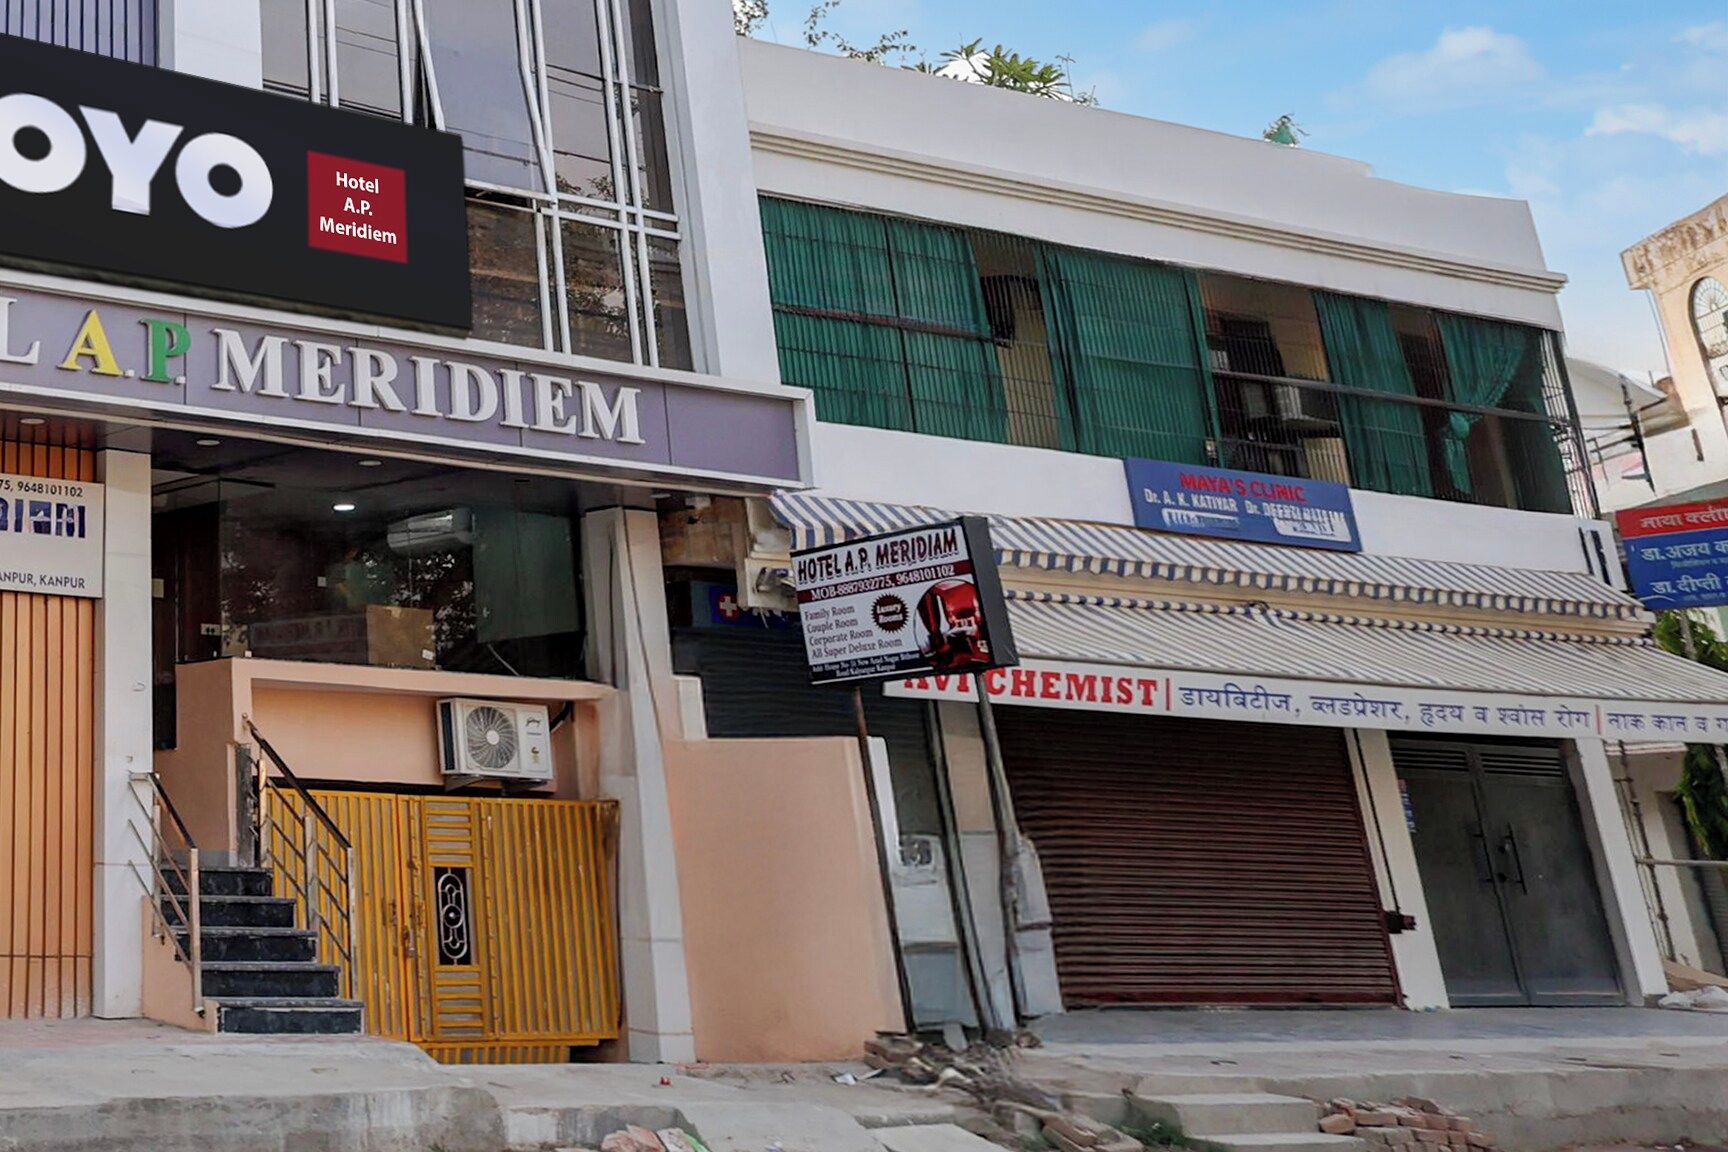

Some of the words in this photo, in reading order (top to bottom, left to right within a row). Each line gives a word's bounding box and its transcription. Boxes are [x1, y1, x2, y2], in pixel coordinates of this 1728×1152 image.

[335, 170, 380, 194] Hotel
[343, 196, 373, 217] A.P.
[319, 215, 397, 245] Meridiem
[210, 327, 647, 445] MERIDIEM
[17, 480, 84, 498] 9648101102
[798, 553, 842, 582] HOTEL
[875, 527, 959, 568] MERIDIAM
[39, 574, 85, 589] KANPUR
[804, 607, 830, 622] Family
[832, 605, 855, 617] Room
[807, 620, 834, 634] Couple
[835, 617, 859, 629] Room
[809, 633, 848, 648] Corporate
[850, 628, 874, 640] Room
[824, 645, 847, 659] Super
[848, 641, 877, 654] Deluxe
[878, 637, 902, 648] Room
[984, 667, 1158, 707] CHEMIST
[1418, 702, 1465, 727] हृदय
[1553, 704, 1591, 728] रोग
[1606, 711, 1646, 731] नाक
[1651, 714, 1687, 733] कान
